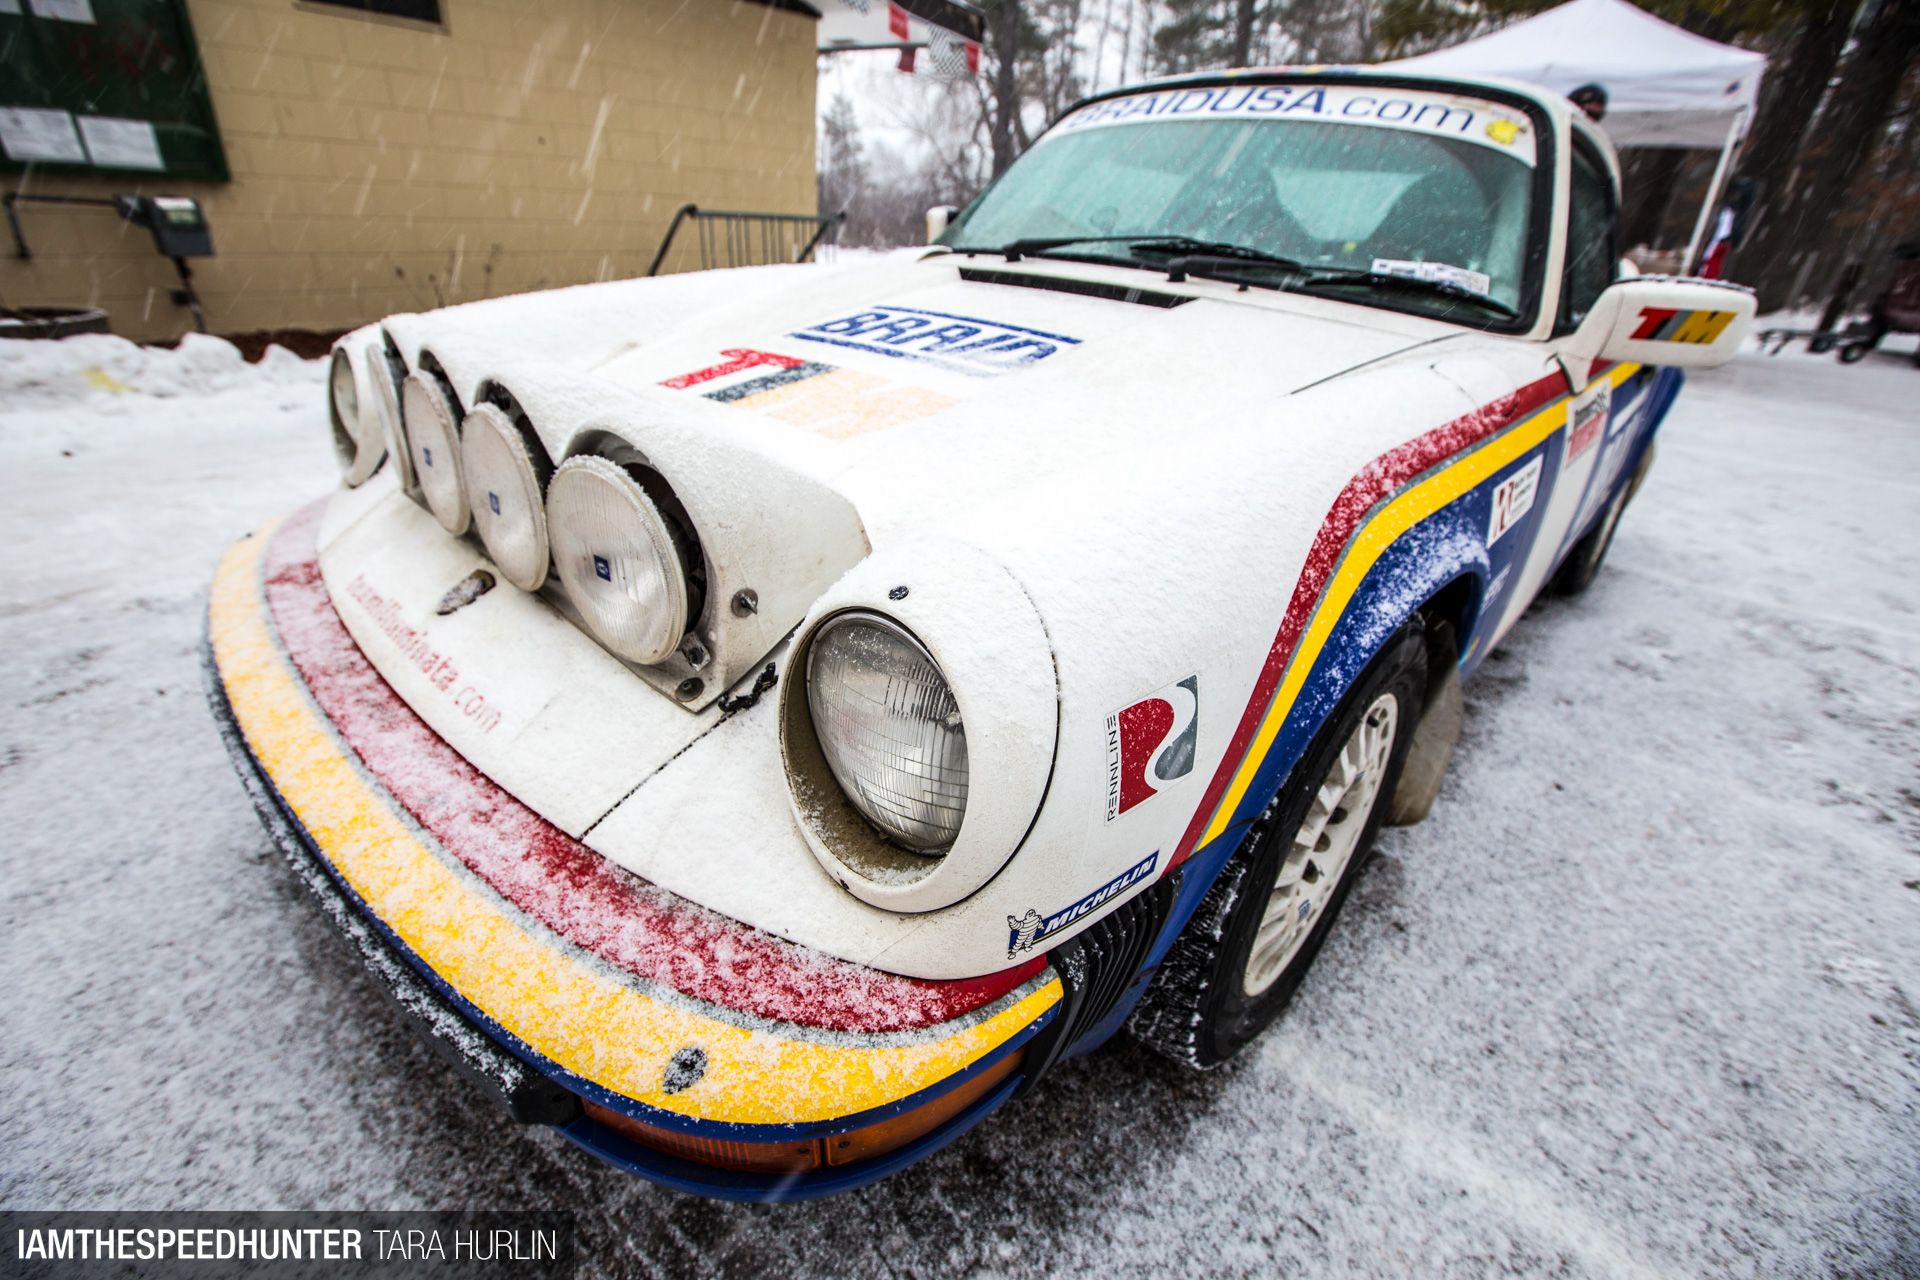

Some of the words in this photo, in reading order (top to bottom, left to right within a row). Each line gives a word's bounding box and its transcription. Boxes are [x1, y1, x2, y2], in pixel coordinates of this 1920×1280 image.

[804, 312, 1058, 369] BRAID
[1106, 714, 1118, 822] RENNLINE
[1044, 856, 1156, 935] MICHELIN
